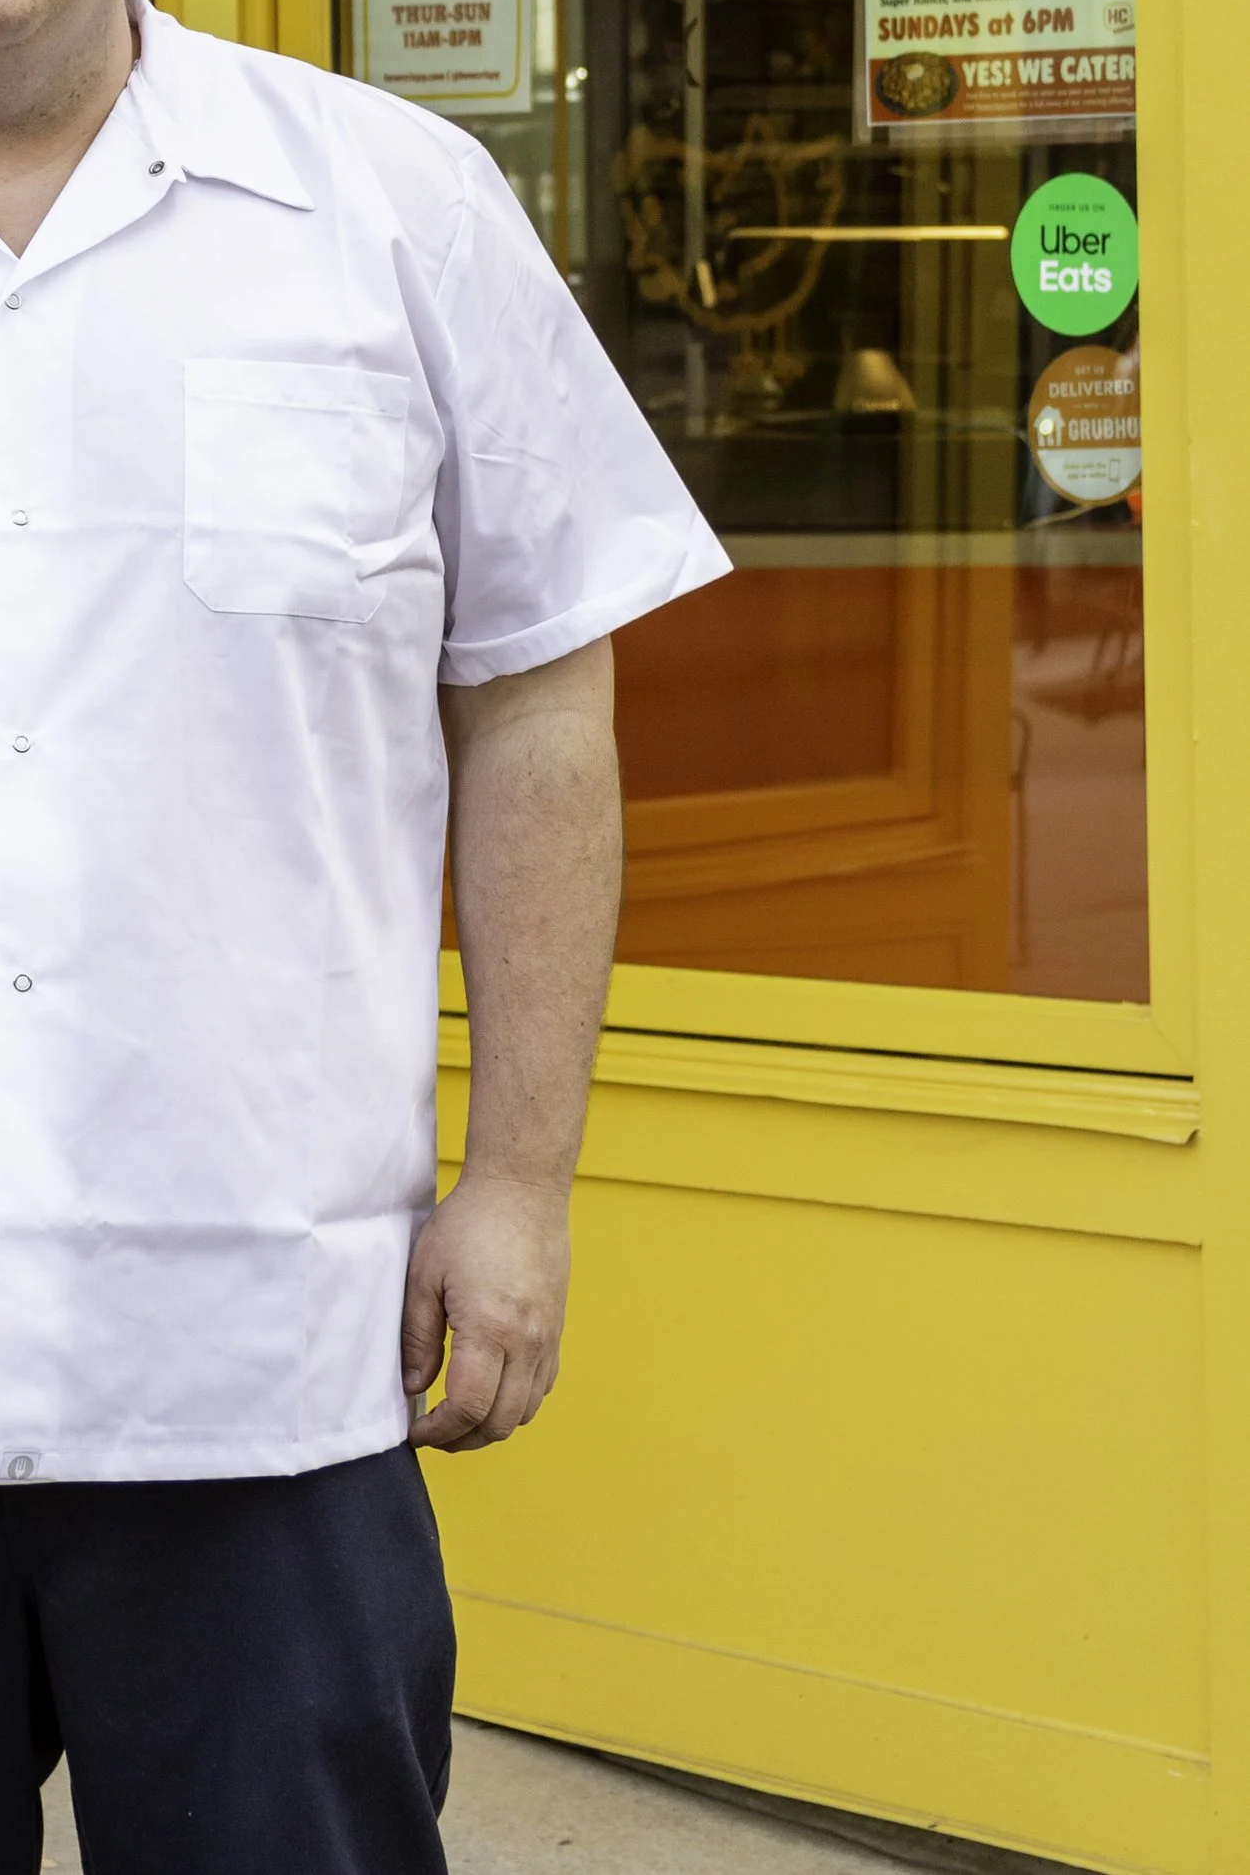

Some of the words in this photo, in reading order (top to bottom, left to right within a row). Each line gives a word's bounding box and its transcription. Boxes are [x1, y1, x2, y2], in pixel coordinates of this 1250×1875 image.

[392, 2, 491, 25] THUR-SUN
[878, 12, 980, 42] SUNDAYS
[988, 13, 1014, 36] at
[1022, 7, 1074, 34] 6PM
[1108, 7, 1128, 24] HC
[962, 59, 1011, 88] YES!
[1018, 56, 1055, 84] WE
[1061, 54, 1134, 83] CATER
[1041, 224, 1111, 255] Uber
[1040, 260, 1112, 293] Eats
[1049, 378, 1134, 398] DELIVERED
[1068, 415, 1141, 441] GRUBHU
